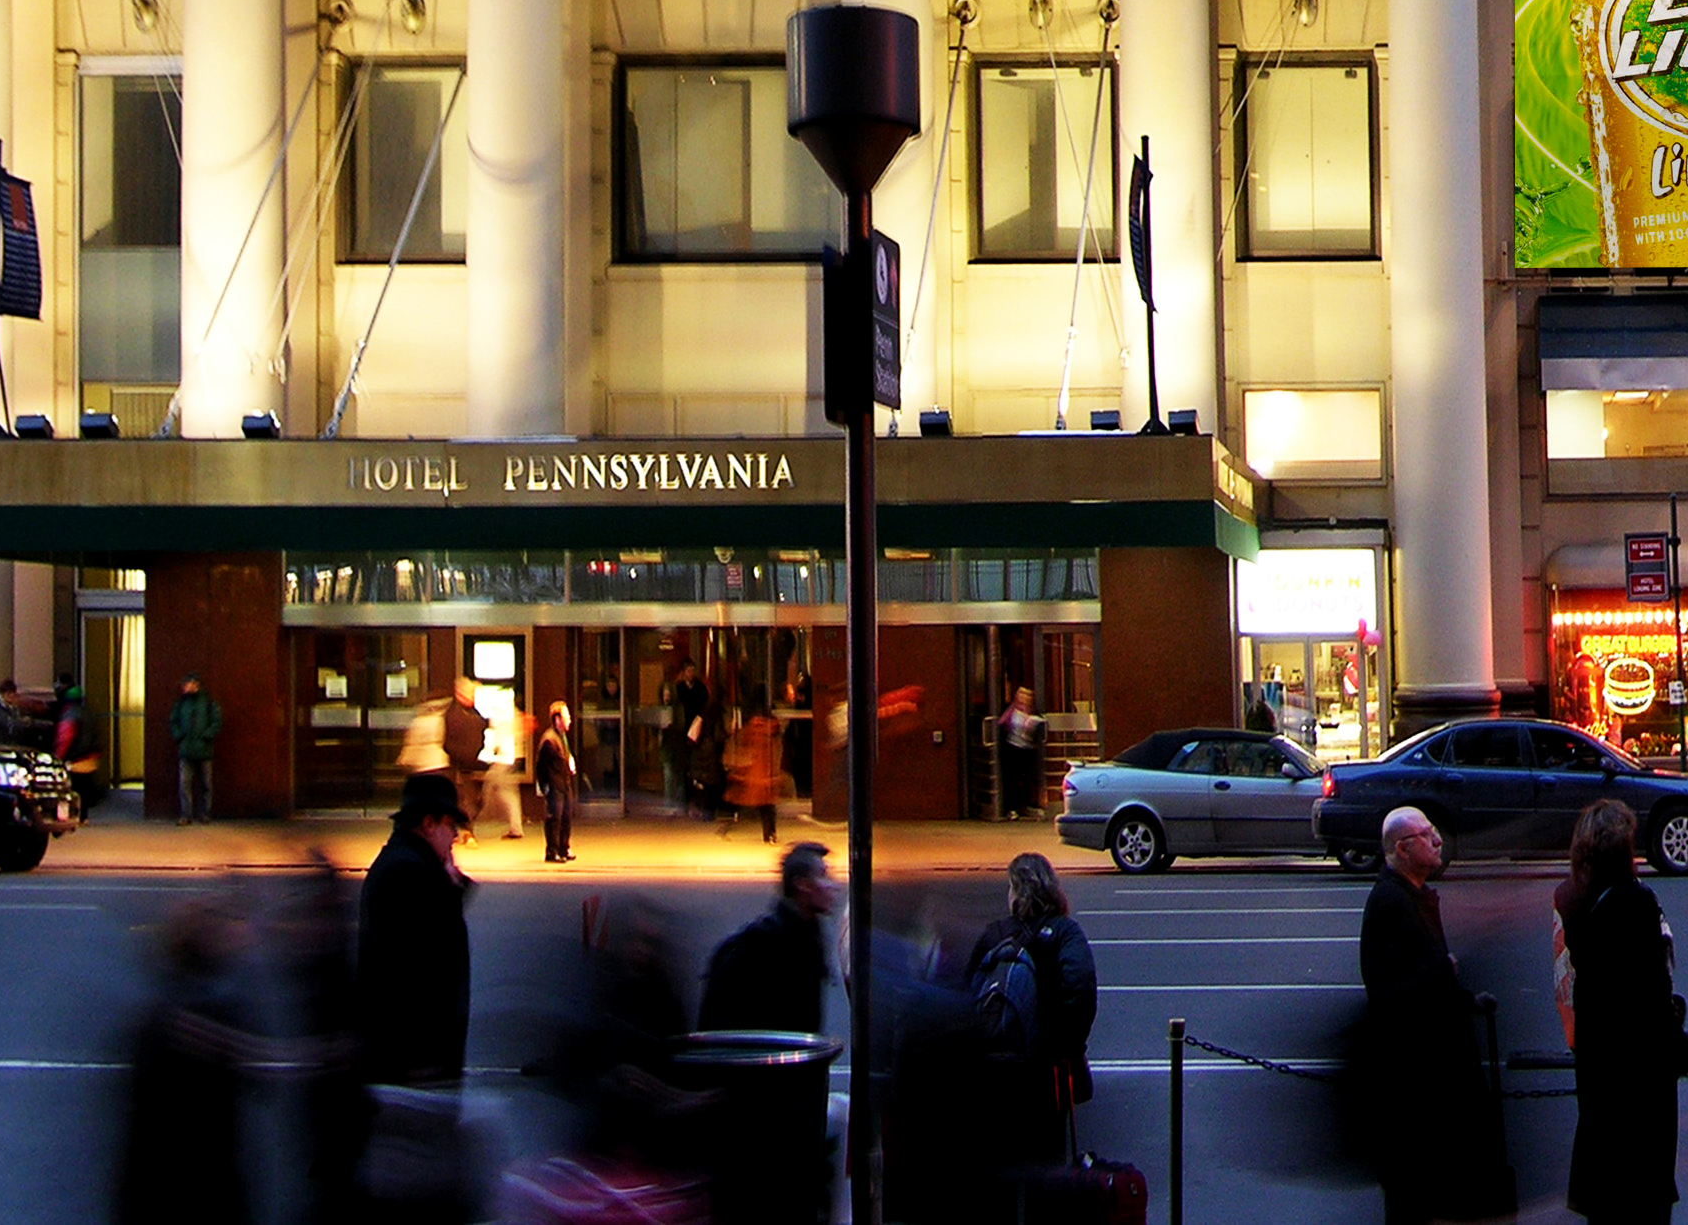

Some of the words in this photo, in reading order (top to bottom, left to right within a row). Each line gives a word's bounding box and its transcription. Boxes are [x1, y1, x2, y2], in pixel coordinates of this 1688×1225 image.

[1635, 230, 1665, 246] WITH
[348, 456, 468, 492] HOTEL
[503, 453, 796, 491] PENNSYLVANIA
[1581, 635, 1628, 654] GREAT
